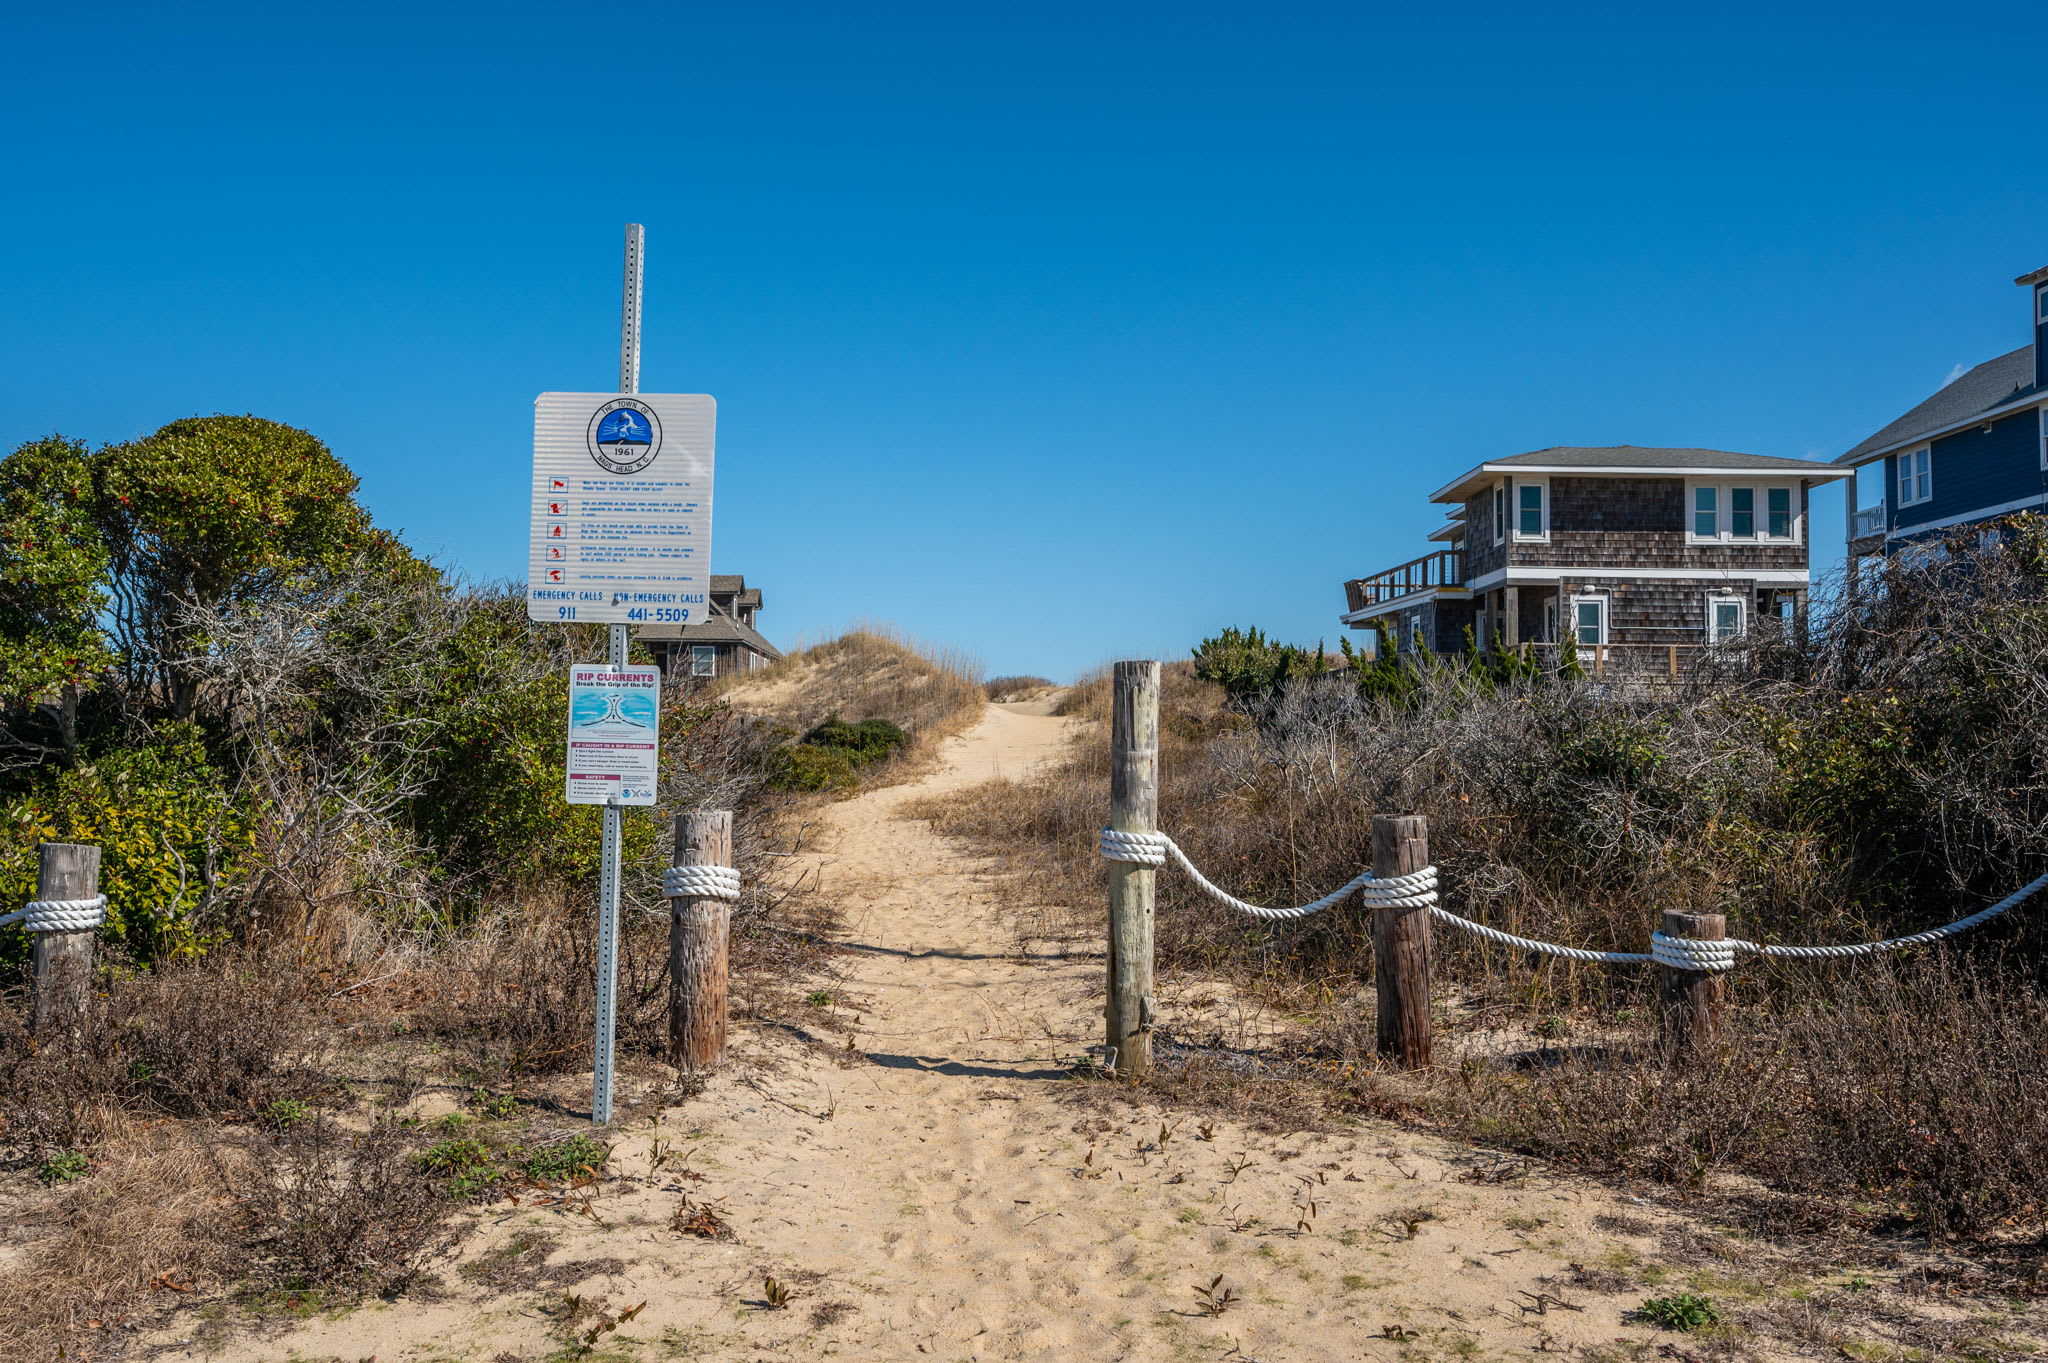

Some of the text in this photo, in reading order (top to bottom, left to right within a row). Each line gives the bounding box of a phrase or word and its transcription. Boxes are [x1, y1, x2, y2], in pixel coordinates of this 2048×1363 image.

[601, 404, 614, 414] THE
[597, 455, 612, 469] NAGS
[533, 590, 603, 601] EMERGENCY CALLS
[614, 592, 704, 603] NON-EMERGENCY CALLS
[558, 607, 576, 620] 911
[627, 608, 689, 621] 441-5509
[597, 673, 654, 682] CURRENTS
